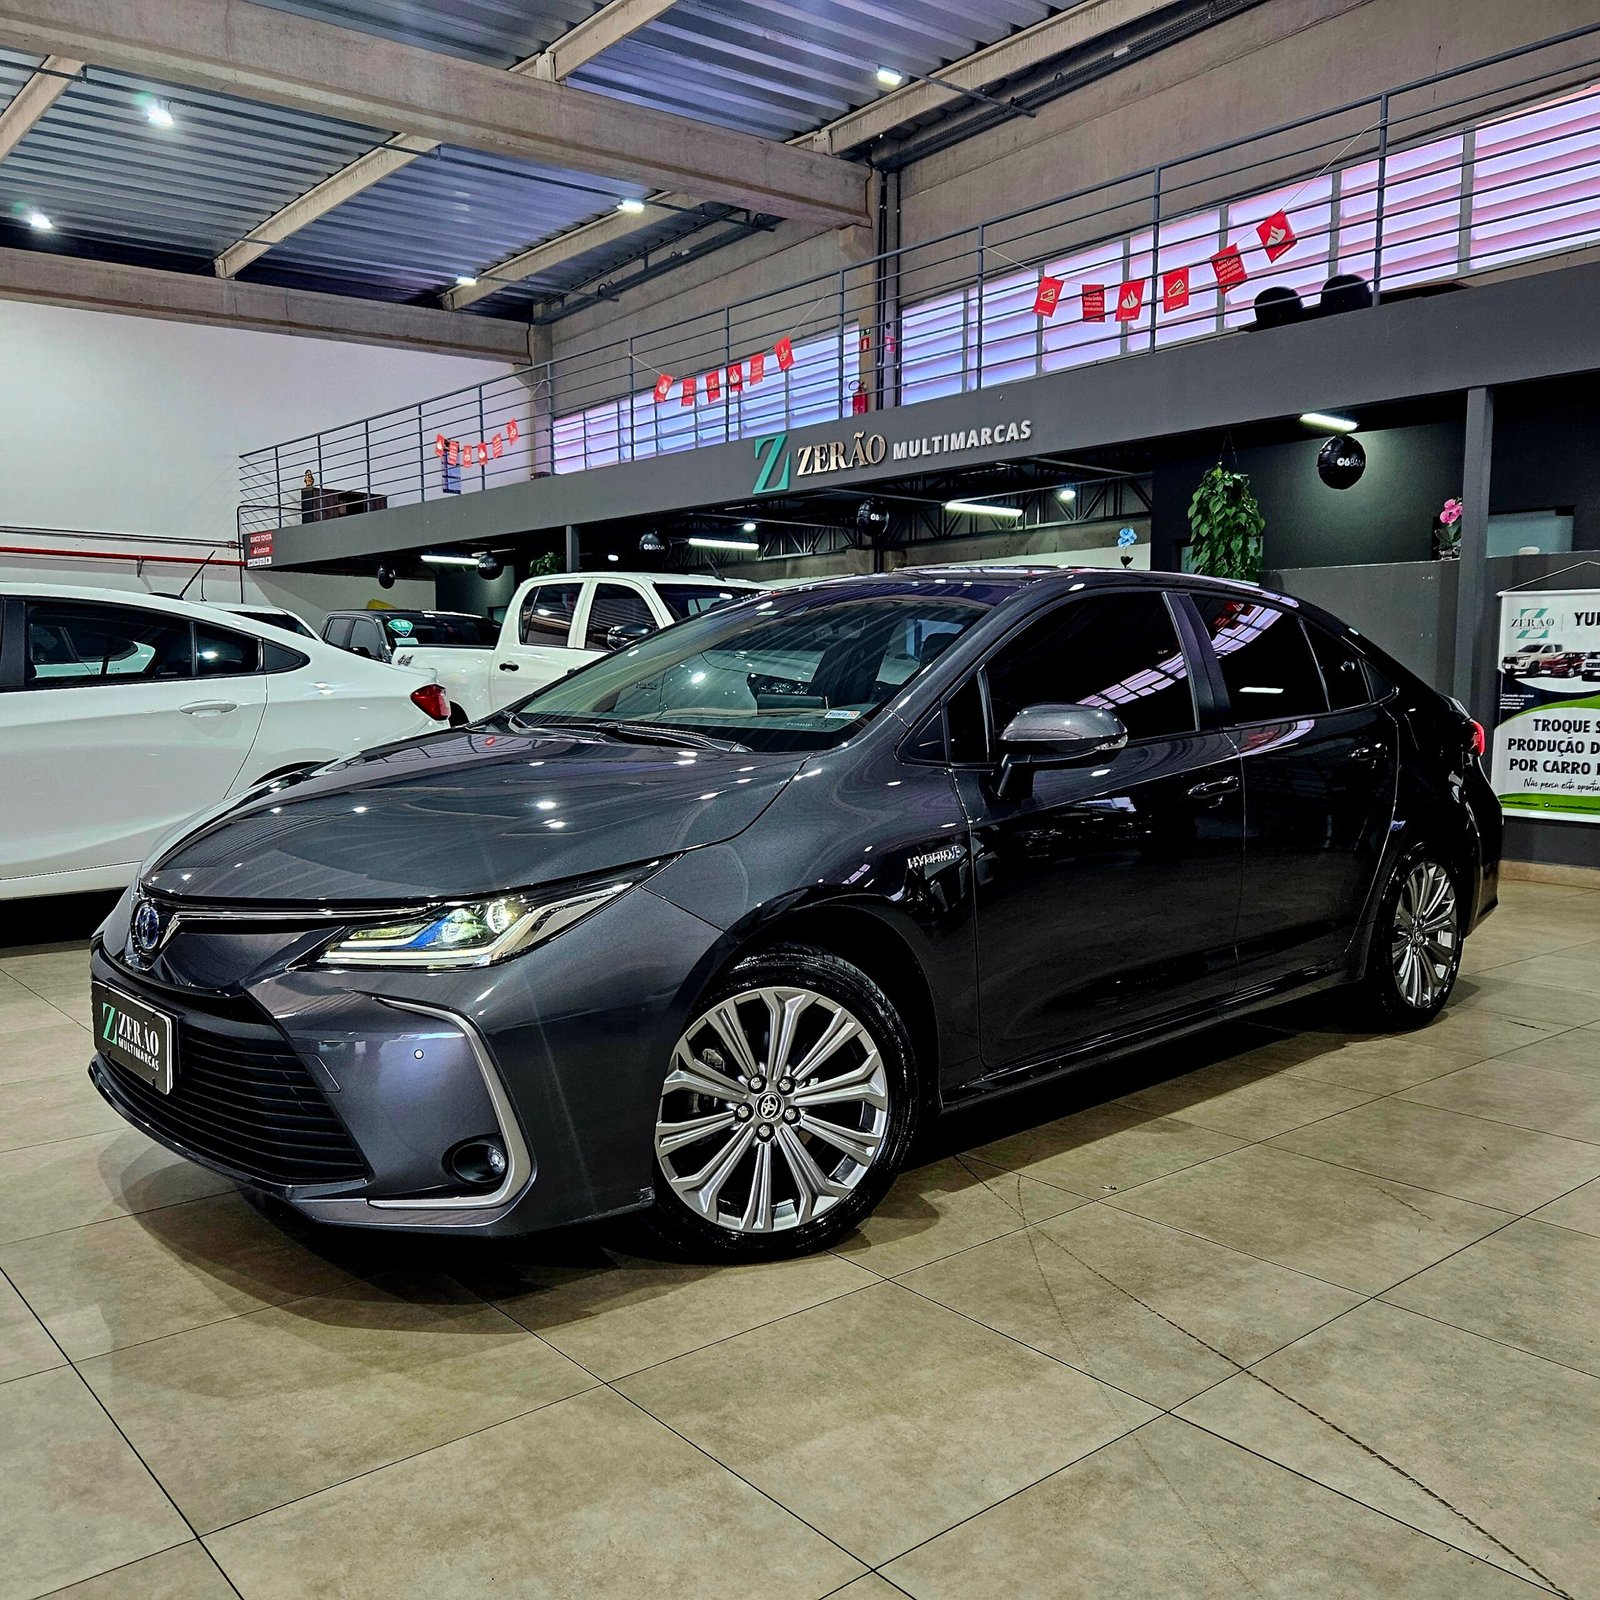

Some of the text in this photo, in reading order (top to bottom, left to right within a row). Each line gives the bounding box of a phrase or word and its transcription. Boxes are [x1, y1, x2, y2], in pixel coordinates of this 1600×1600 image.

[796, 431, 887, 476] ZERÃO
[893, 420, 1032, 460] MULTIMARCAS
[1533, 719, 1591, 734] TROQUE
[1508, 736, 1585, 757] PRODUÇÃO
[1509, 758, 1538, 772] POR
[1543, 760, 1591, 775] CARRO
[118, 1036, 159, 1072] MULTIMARCAS
